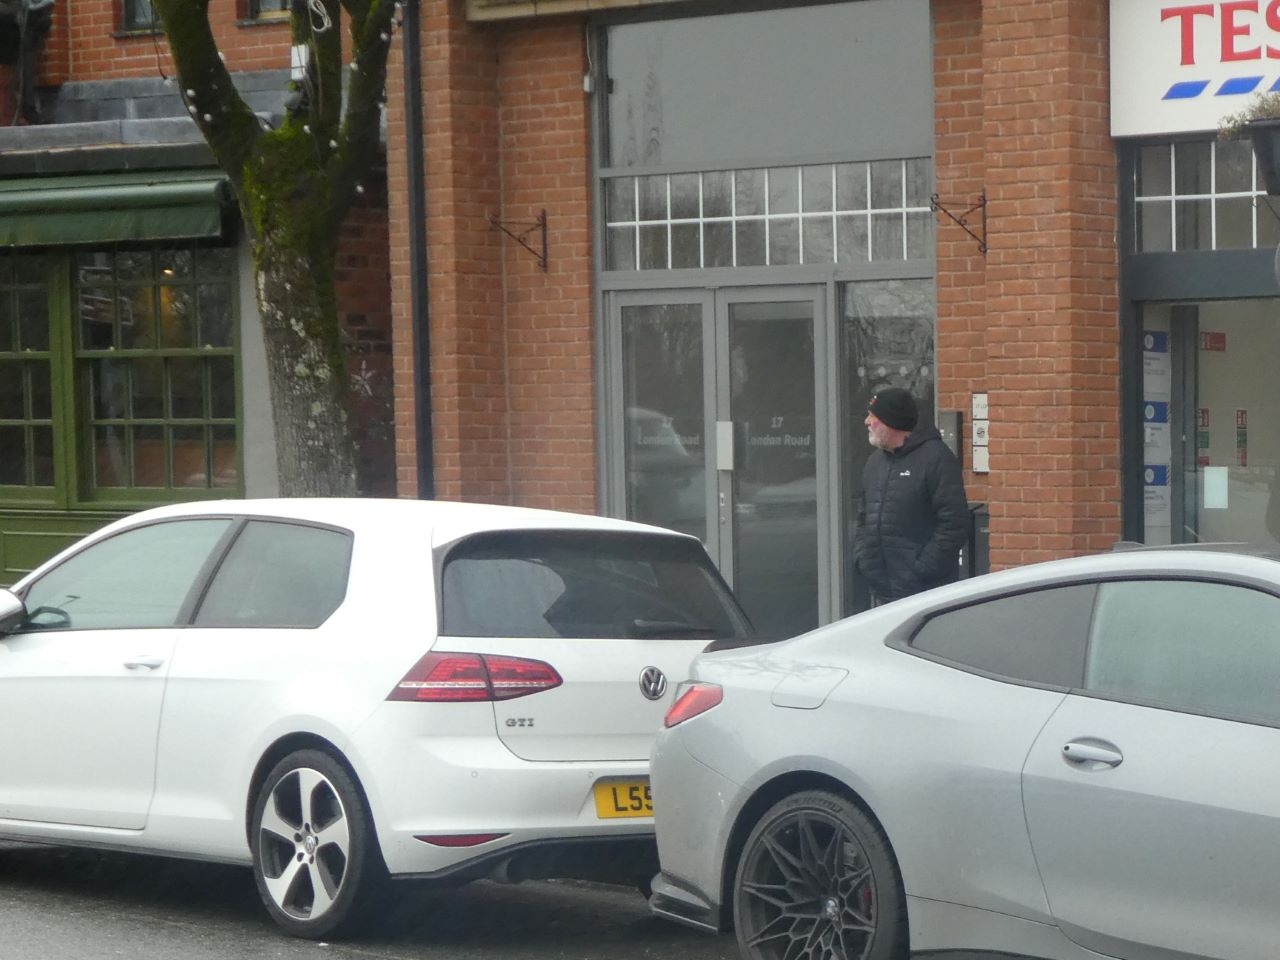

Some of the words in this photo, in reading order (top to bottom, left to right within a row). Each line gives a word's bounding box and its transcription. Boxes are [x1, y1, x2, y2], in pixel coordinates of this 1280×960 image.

[771, 416, 784, 428] 17
[784, 434, 810, 446] Road
[506, 718, 535, 727] GTI
